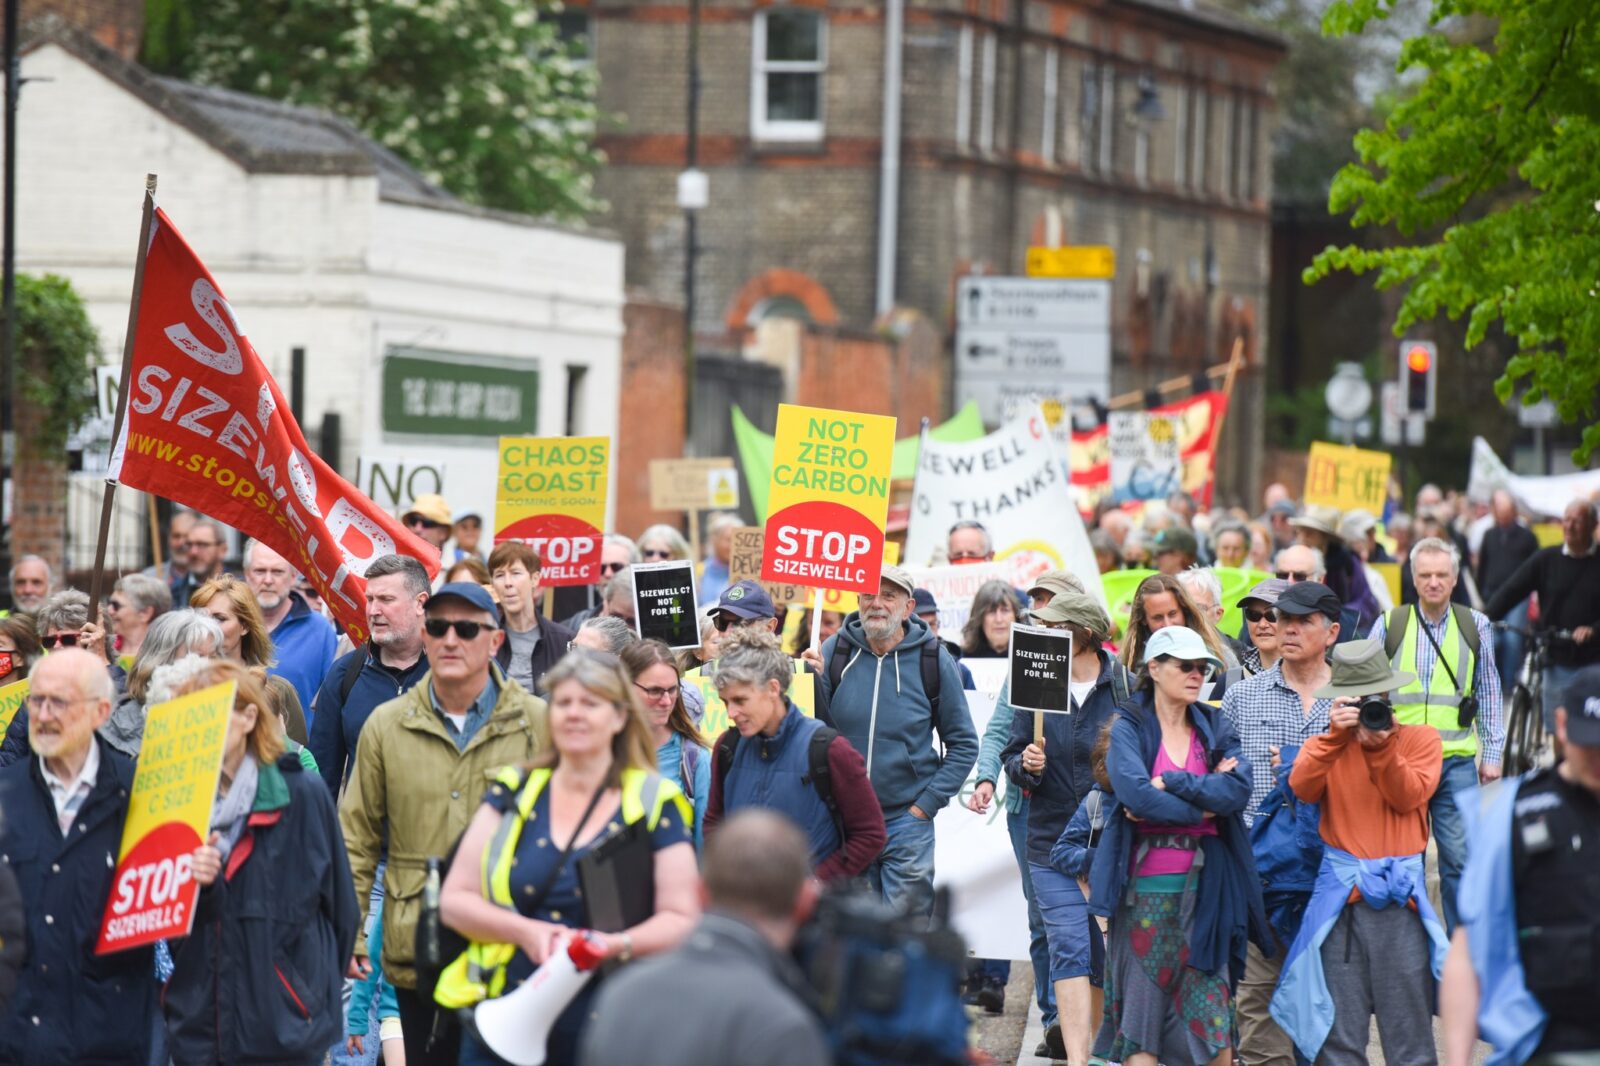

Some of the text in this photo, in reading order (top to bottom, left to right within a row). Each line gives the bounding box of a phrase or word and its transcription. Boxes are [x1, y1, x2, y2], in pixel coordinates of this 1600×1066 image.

[808, 418, 864, 443] NOT
[503, 445, 605, 467] CHAOS
[797, 442, 868, 470] ZERO
[503, 470, 602, 493] COAST
[773, 464, 887, 498] CARBON
[950, 460, 1056, 519] THANKS
[505, 497, 596, 506] COMING SOON
[510, 537, 594, 564] TOP
[735, 532, 764, 548] SIZE
[775, 525, 871, 564] STOP
[580, 566, 590, 578] C
[773, 558, 866, 583] SIZEWELL C
[640, 586, 690, 598] SIZEWELL C?
[657, 597, 673, 606] NOT
[651, 606, 685, 616] FOR ME.
[1015, 649, 1067, 662] SIZEWELL C?
[1031, 661, 1048, 669] NOT
[1024, 669, 1058, 679] FOR ME.
[143, 723, 222, 766] LIKE TO BE
[135, 749, 219, 794] BESIDE THE
[148, 782, 195, 815] C SIZE
[112, 853, 193, 914] STOP
[105, 902, 184, 941] SIZEWELL C
